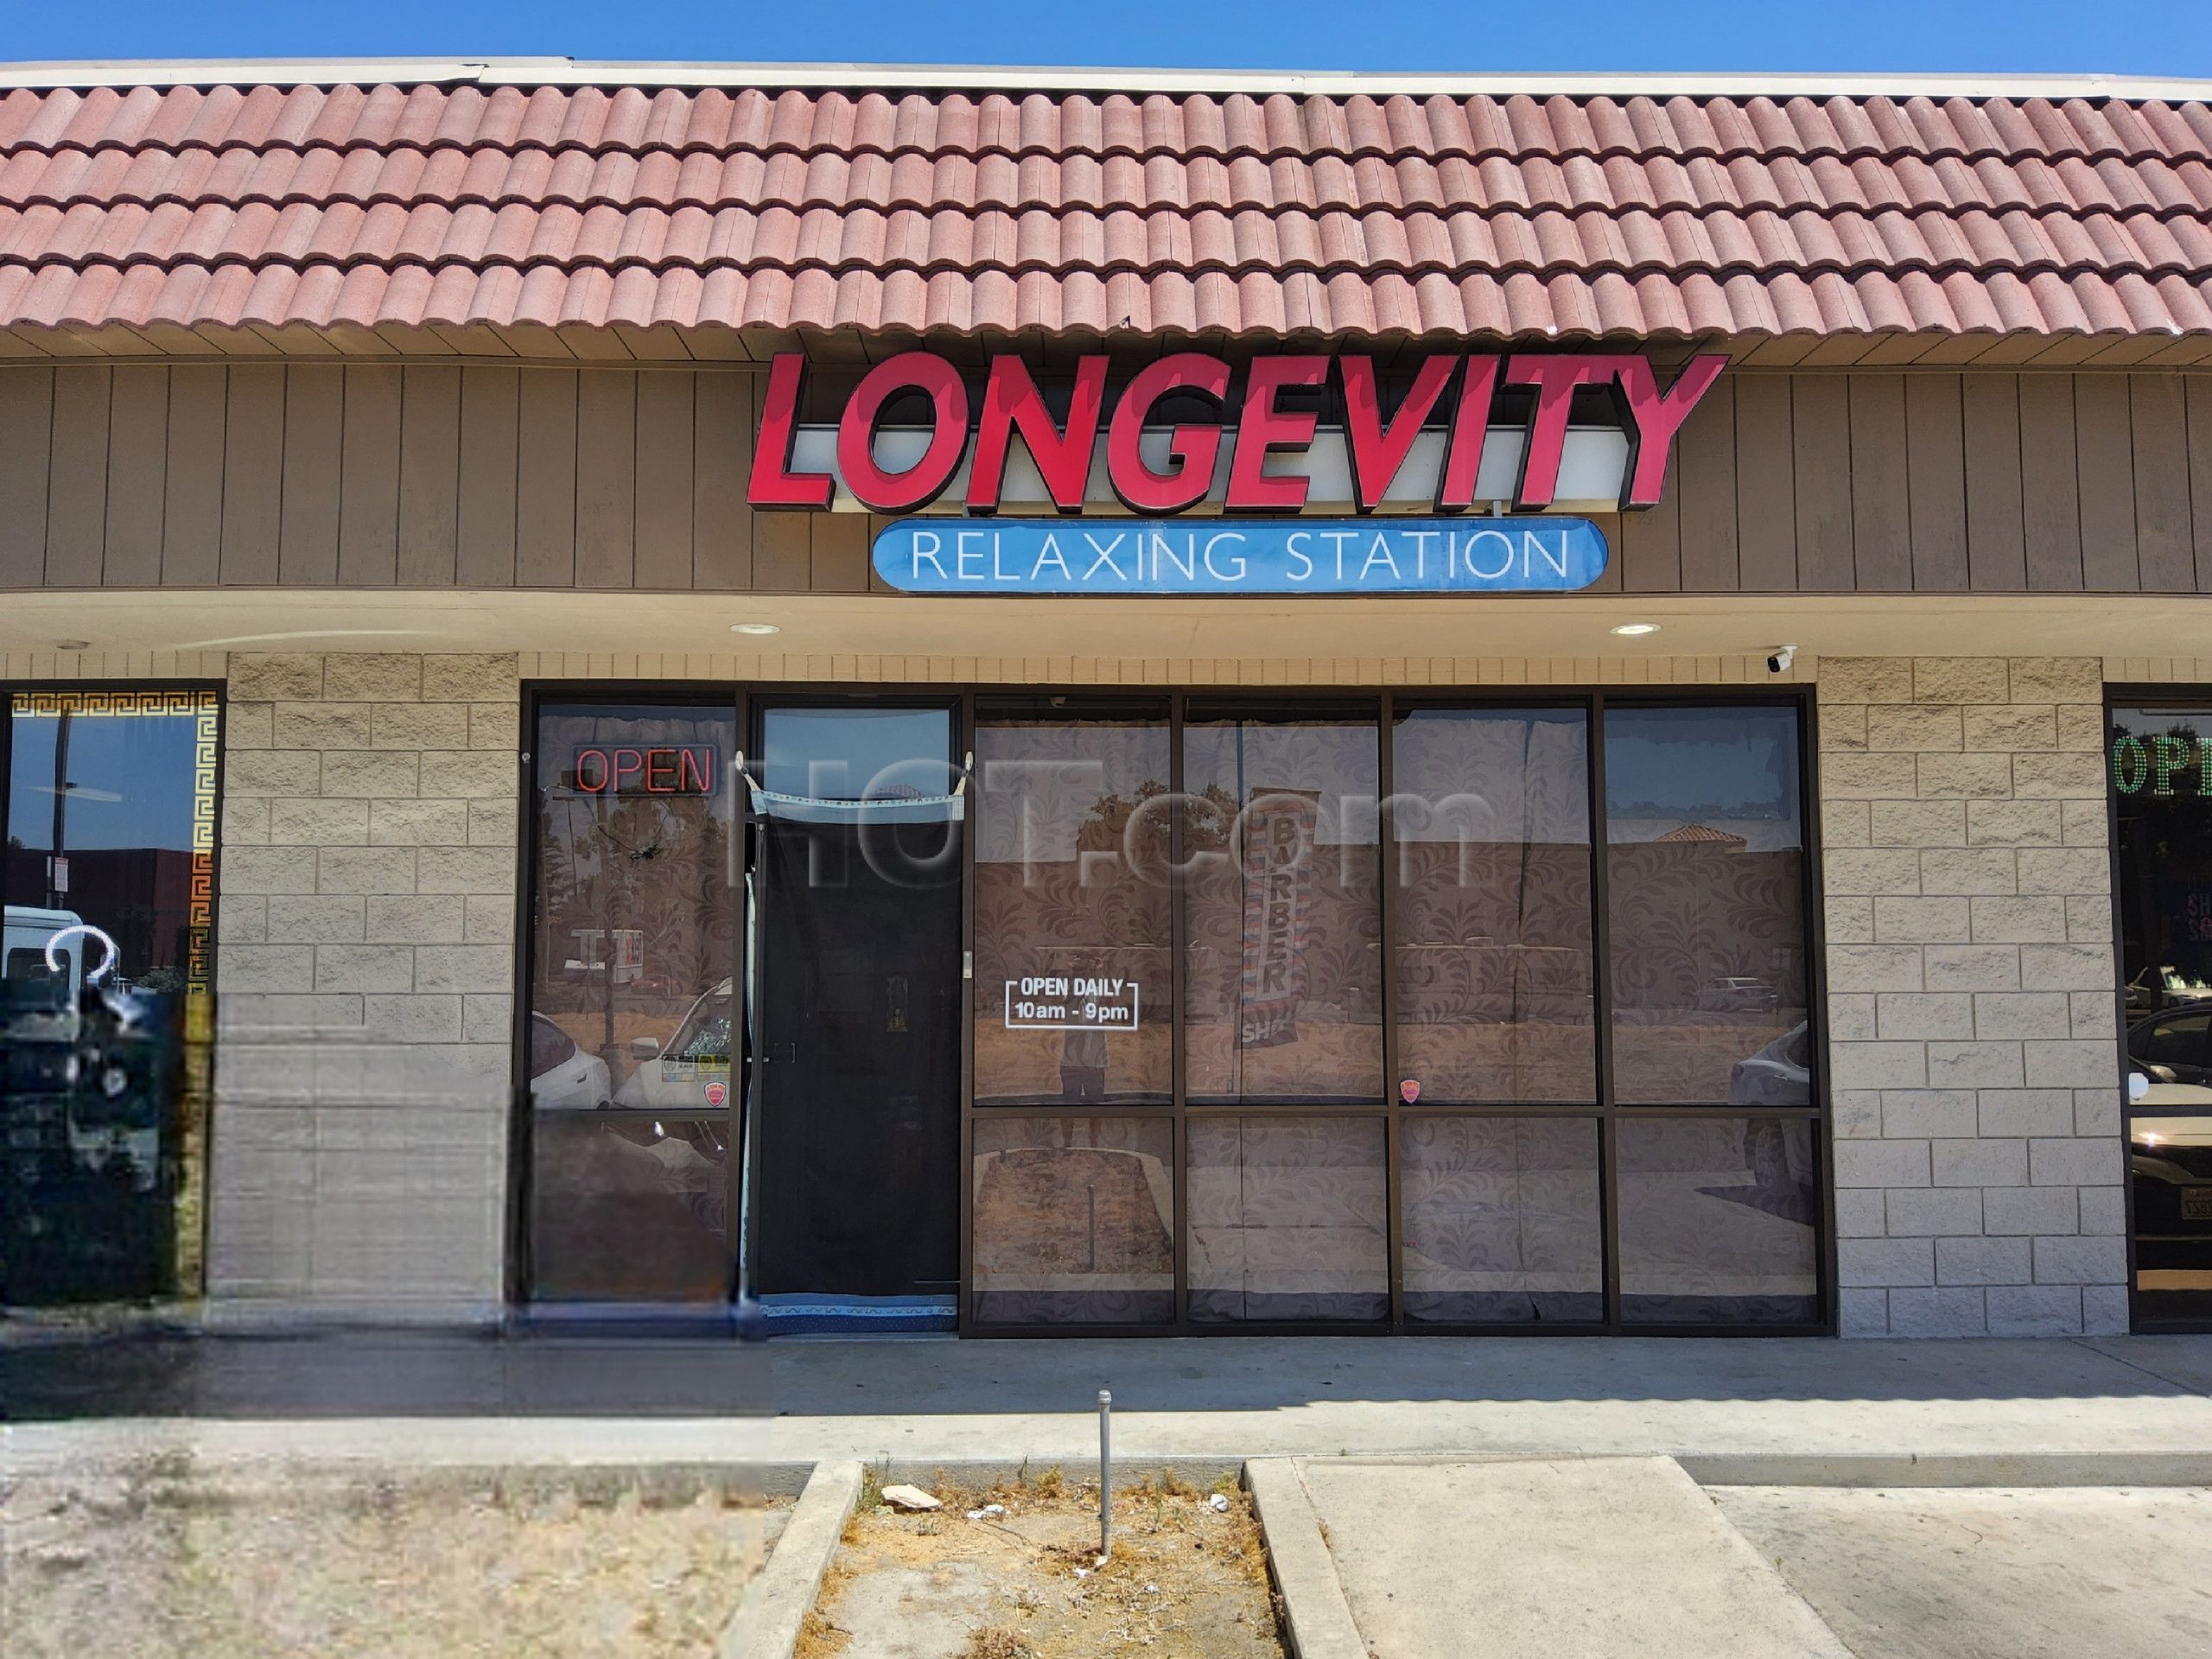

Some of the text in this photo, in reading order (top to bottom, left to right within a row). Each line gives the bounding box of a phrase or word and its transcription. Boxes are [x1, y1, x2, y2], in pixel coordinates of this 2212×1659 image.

[746, 352, 1732, 513] LONGEVITY
[912, 531, 1567, 582] RELAXING STATION
[575, 747, 712, 793] OPEN
[1262, 817, 1295, 994] BARBER
[1021, 977, 1123, 996] OPEN DAILY
[1014, 1001, 1065, 1019] 10am
[1084, 1002, 1128, 1022] 9pm
